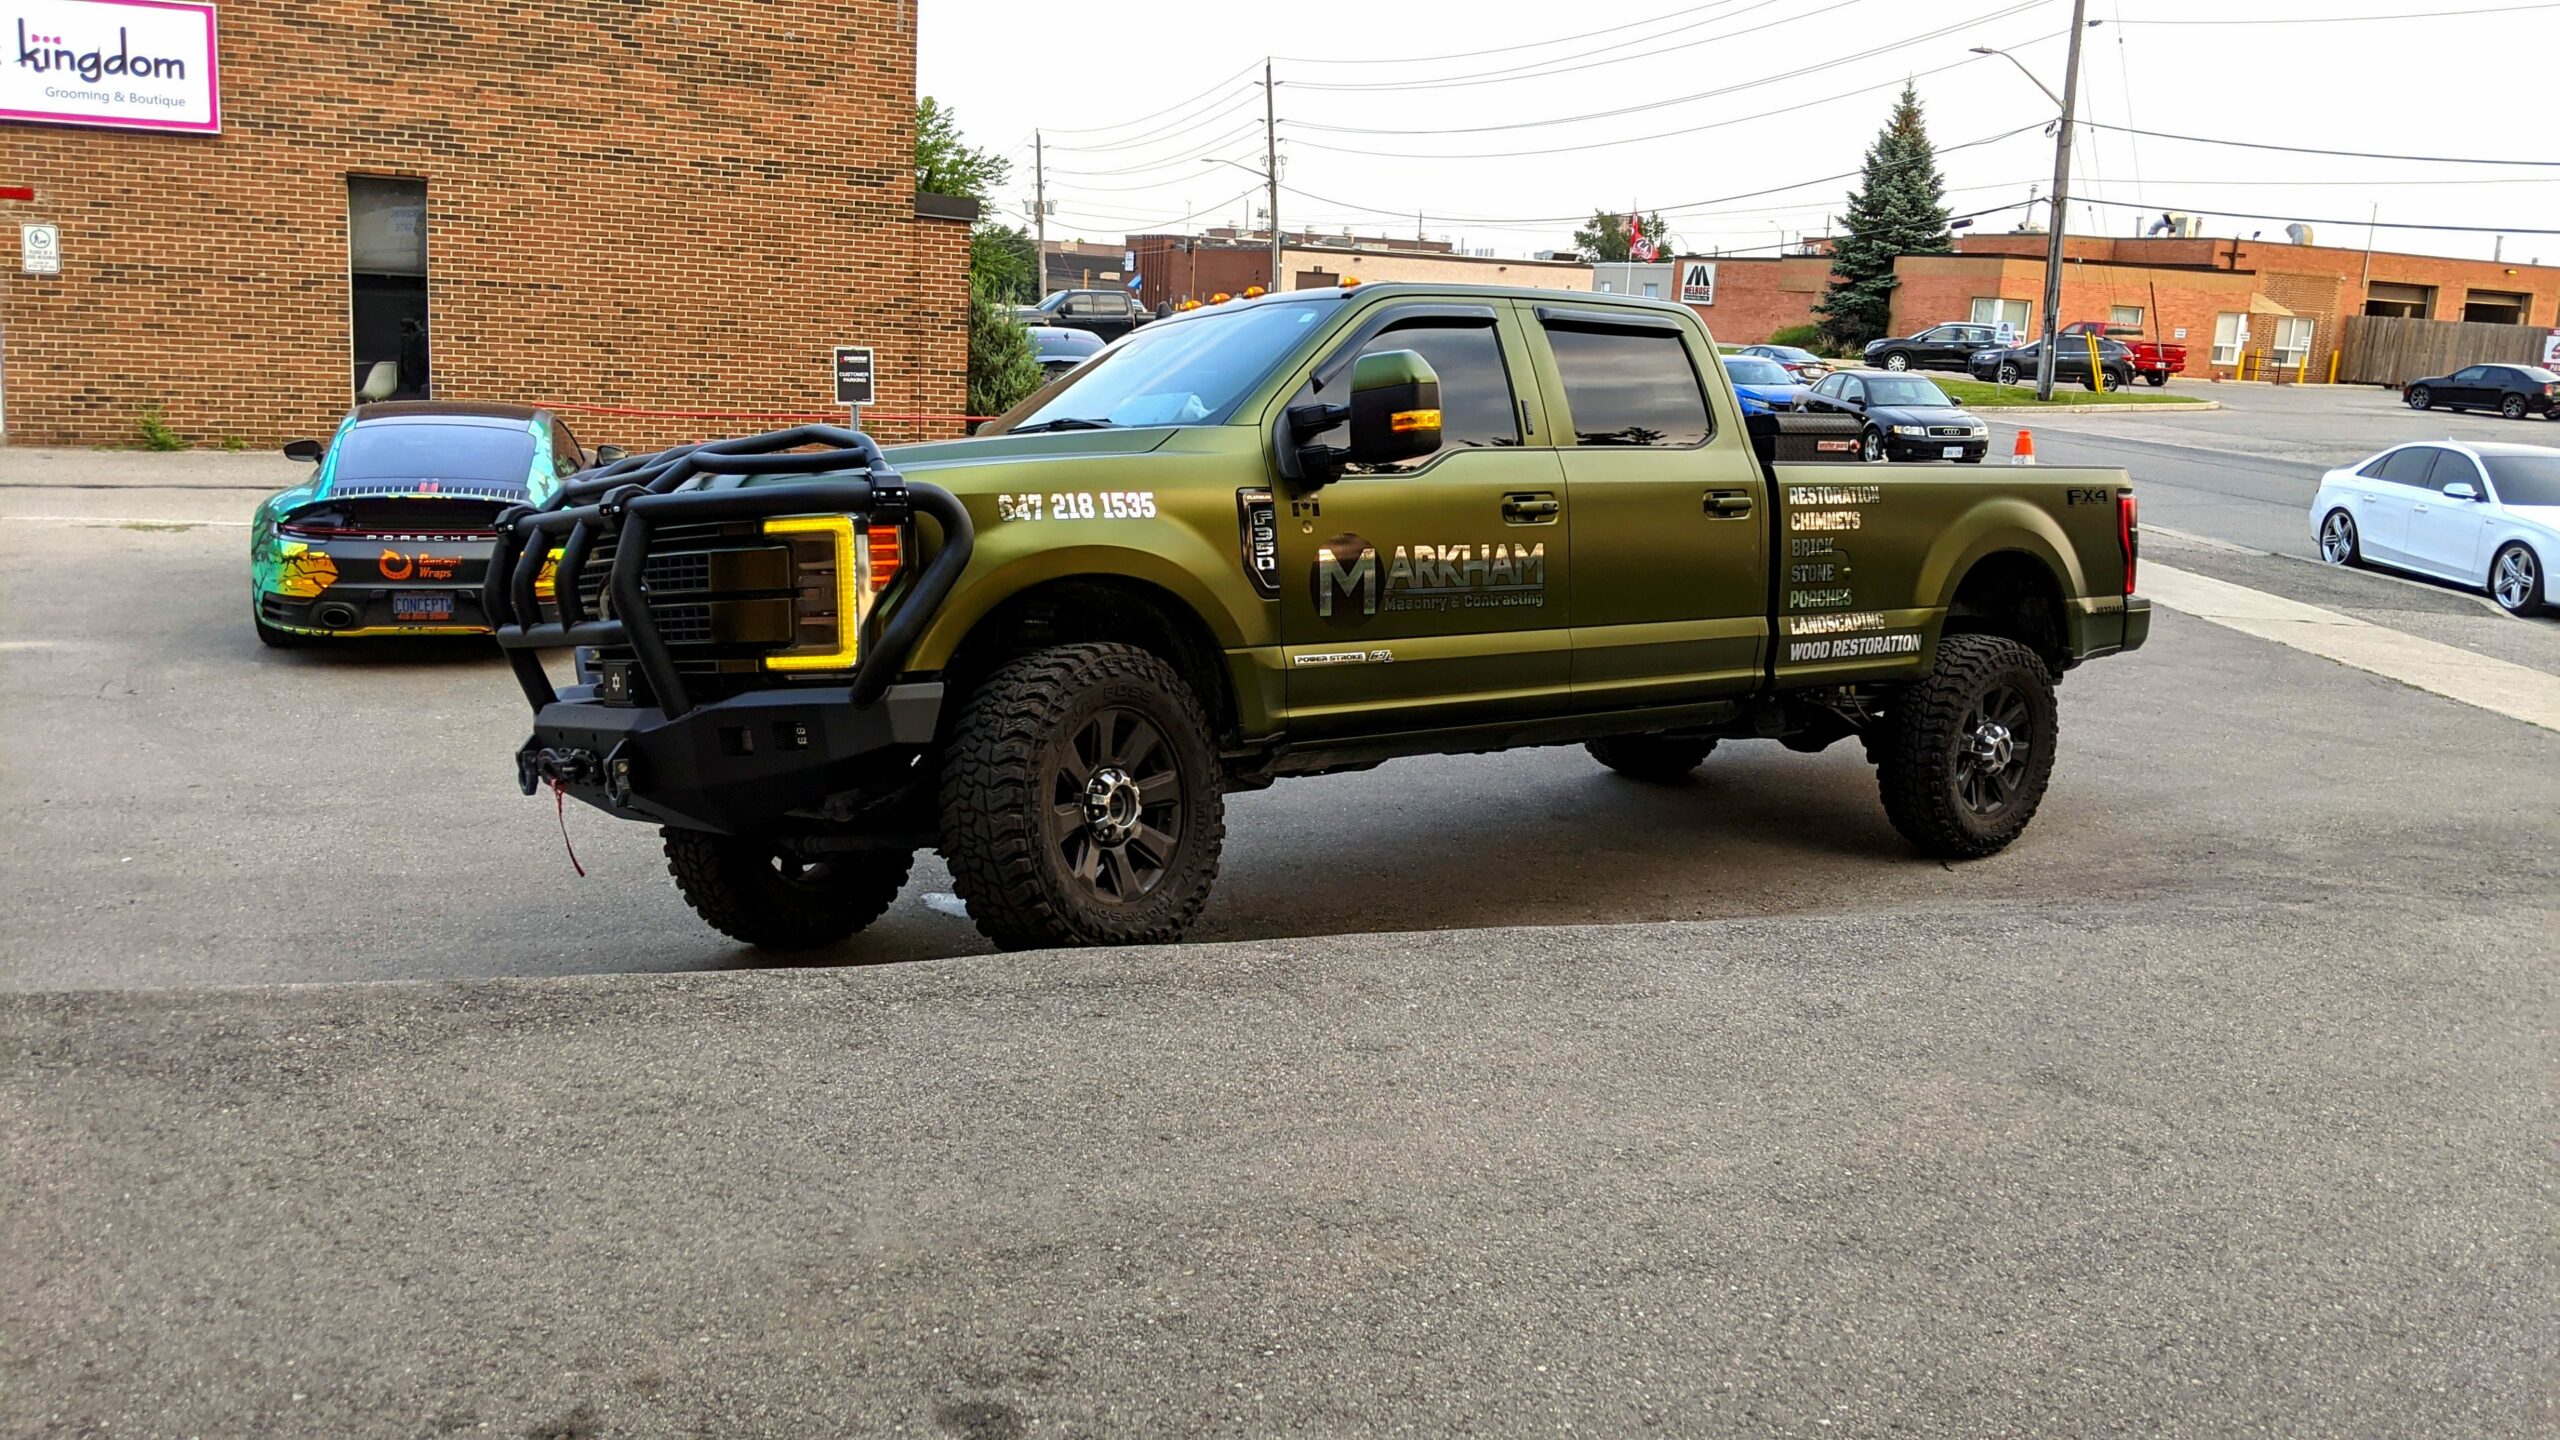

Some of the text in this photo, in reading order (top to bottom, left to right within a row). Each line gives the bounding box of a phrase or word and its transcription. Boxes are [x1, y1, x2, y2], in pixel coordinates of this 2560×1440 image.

[17, 17, 185, 83] kingdom
[45, 86, 186, 108] Grooming & Boutique
[1789, 486, 1881, 505] RESTORATION
[2067, 489, 2108, 506] FX4
[998, 492, 1157, 522] 647 218 1535
[1790, 511, 1861, 531] CHIMNEYS
[1791, 537, 1835, 557] BRICK
[420, 567, 452, 580] Wraps
[1791, 564, 1835, 583] STONE
[1384, 597, 1447, 612] Masonry
[1464, 591, 1544, 609] Contracting
[1789, 589, 1853, 609] PORCHES
[1790, 612, 1886, 635] LANDSCAPING
[1790, 634, 1923, 661] WOOD RESTORATION
[1297, 653, 1364, 663] POWER STROKE
